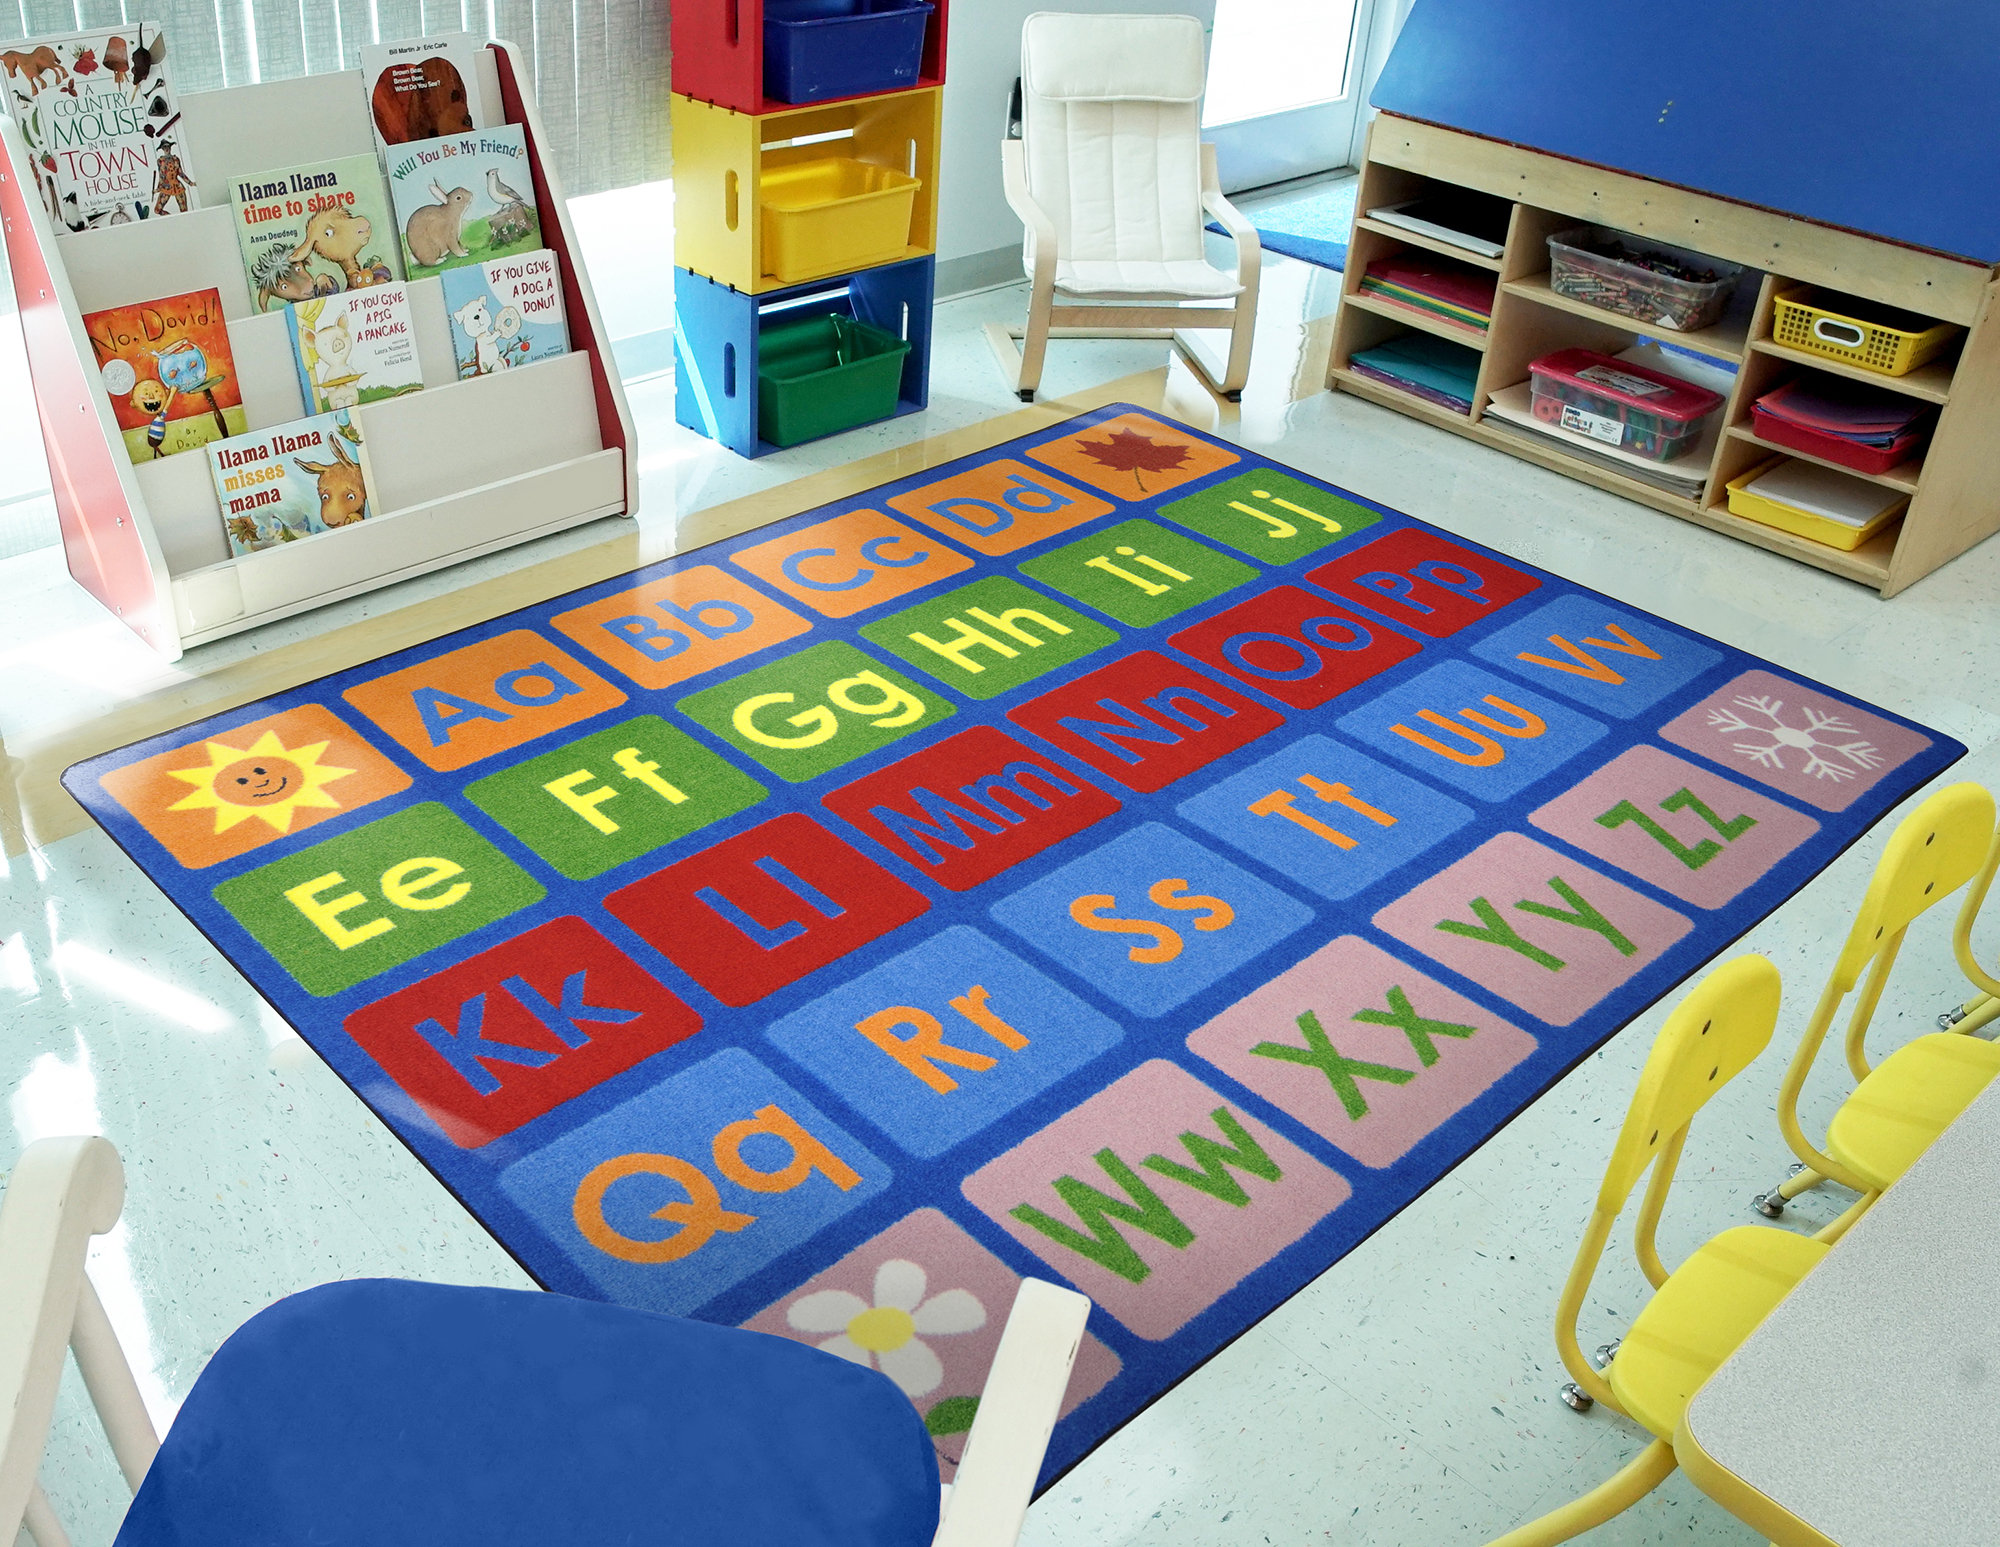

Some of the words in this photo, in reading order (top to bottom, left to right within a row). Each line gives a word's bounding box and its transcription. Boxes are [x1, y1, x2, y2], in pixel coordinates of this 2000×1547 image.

[85, 84, 94, 95] A
[54, 92, 128, 117] COUNTRY
[54, 106, 144, 149] MOUSE
[88, 141, 98, 151] IN
[100, 138, 116, 150] THE
[60, 144, 149, 181] TOWN
[392, 156, 418, 181] Will
[416, 149, 440, 166] You
[442, 144, 458, 159] Be
[460, 141, 477, 157] My
[480, 139, 524, 160] Friend?
[85, 173, 139, 196] HOUSE
[238, 181, 288, 202] llama
[290, 172, 337, 193] llama
[244, 204, 282, 225] time
[286, 200, 303, 217] to
[308, 191, 355, 212] share
[250, 235, 267, 244] Anna
[268, 229, 298, 241] Dewdney
[490, 269, 501, 284] IF
[503, 265, 523, 280] YOU
[526, 260, 552, 275] GIVE
[512, 286, 520, 298] A
[521, 281, 544, 296] DOG
[547, 278, 554, 291] A
[349, 301, 361, 313] IF
[361, 296, 380, 310] YOU
[381, 291, 405, 306] GIVE
[523, 295, 556, 314] DONUT
[366, 312, 373, 325] A
[374, 308, 392, 322] PIG
[356, 331, 365, 343] A
[365, 321, 408, 341] PANCAKE
[218, 445, 269, 470] llama
[272, 431, 322, 456] llama
[224, 464, 285, 492] misses
[229, 488, 282, 514] mama
[412, 662, 583, 746] Aa
[601, 601, 753, 661] Bb
[782, 537, 928, 591] Cc
[928, 475, 1073, 536] Dd
[285, 858, 470, 949] Ee
[546, 749, 687, 833] Ff
[734, 671, 924, 748] Gg
[910, 608, 1070, 672] Hh
[1086, 547, 1190, 595] Ii
[1229, 491, 1340, 537] Jj
[414, 971, 641, 1095] Kk
[695, 856, 845, 949] Ll
[869, 762, 1079, 865] Mm
[1058, 687, 1236, 764] Nn
[1222, 617, 1372, 680] Oo
[1353, 561, 1488, 614] Pp
[574, 1105, 861, 1263] Qq
[856, 986, 1029, 1094] Rr
[1071, 879, 1234, 963] Ss
[1249, 774, 1397, 849] Tt
[1390, 695, 1546, 766] Uu
[1518, 624, 1662, 684] Vv
[1010, 1108, 1281, 1284] Ww
[1250, 987, 1475, 1121] Xx
[1436, 878, 1636, 971] Yy
[1596, 788, 1756, 870] Zz
